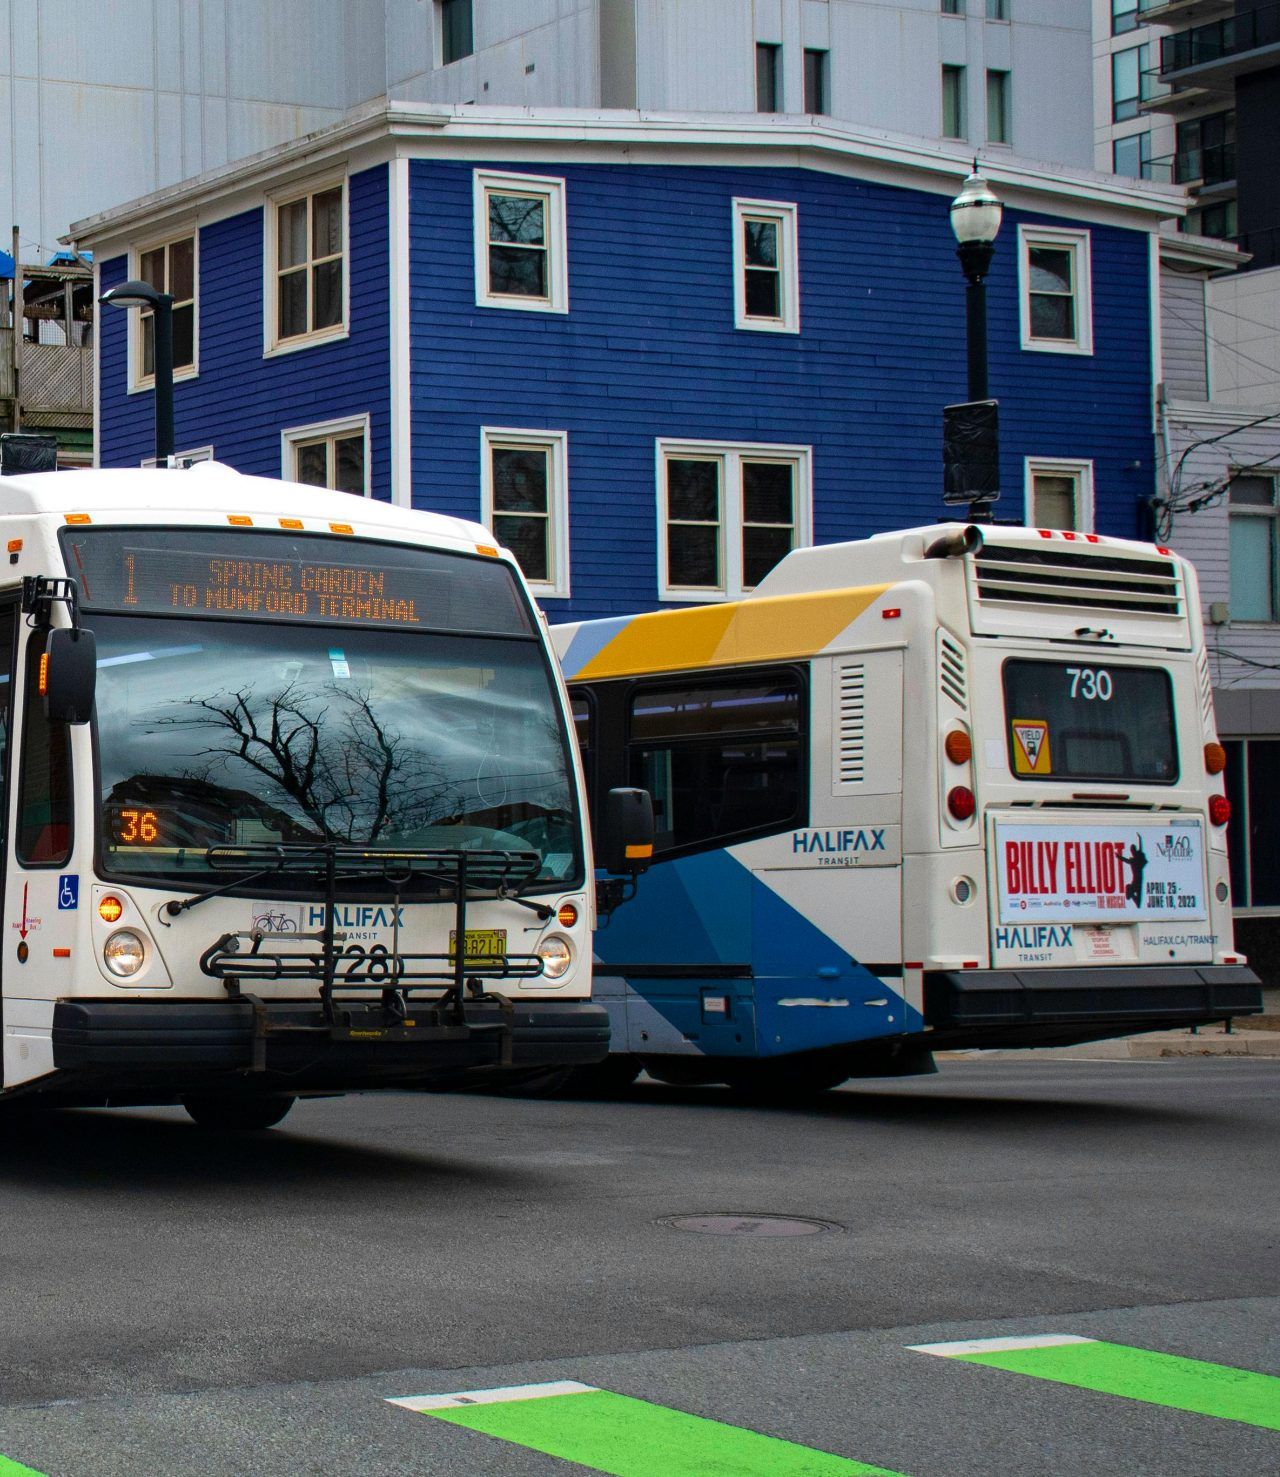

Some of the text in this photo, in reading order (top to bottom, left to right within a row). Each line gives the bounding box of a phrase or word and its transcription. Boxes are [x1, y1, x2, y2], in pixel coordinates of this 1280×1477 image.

[209, 559, 293, 591] SPRING
[301, 566, 384, 596] GARDEN
[170, 582, 421, 622] TO MUMFORD TERMINAL
[1066, 668, 1113, 701] 730
[1019, 729, 1041, 740] YIELD
[121, 811, 157, 841] 36
[793, 829, 885, 853] HALIFAX
[818, 856, 860, 866] TRANSIT
[1005, 841, 1126, 895] BILLY ELLIOT
[1146, 882, 1166, 895] APRIL
[1167, 882, 1177, 895] 25
[1147, 895, 1164, 909] JUNE
[1178, 895, 1196, 909] 2023
[309, 905, 405, 928] HALIFAX
[337, 932, 378, 940] RANSIT
[995, 926, 1073, 949] HALIFAX
[1143, 934, 1219, 947] HALIFAX.CA/TRANSIT
[322, 944, 389, 983] 728
[1018, 953, 1053, 962] TRANSIT
